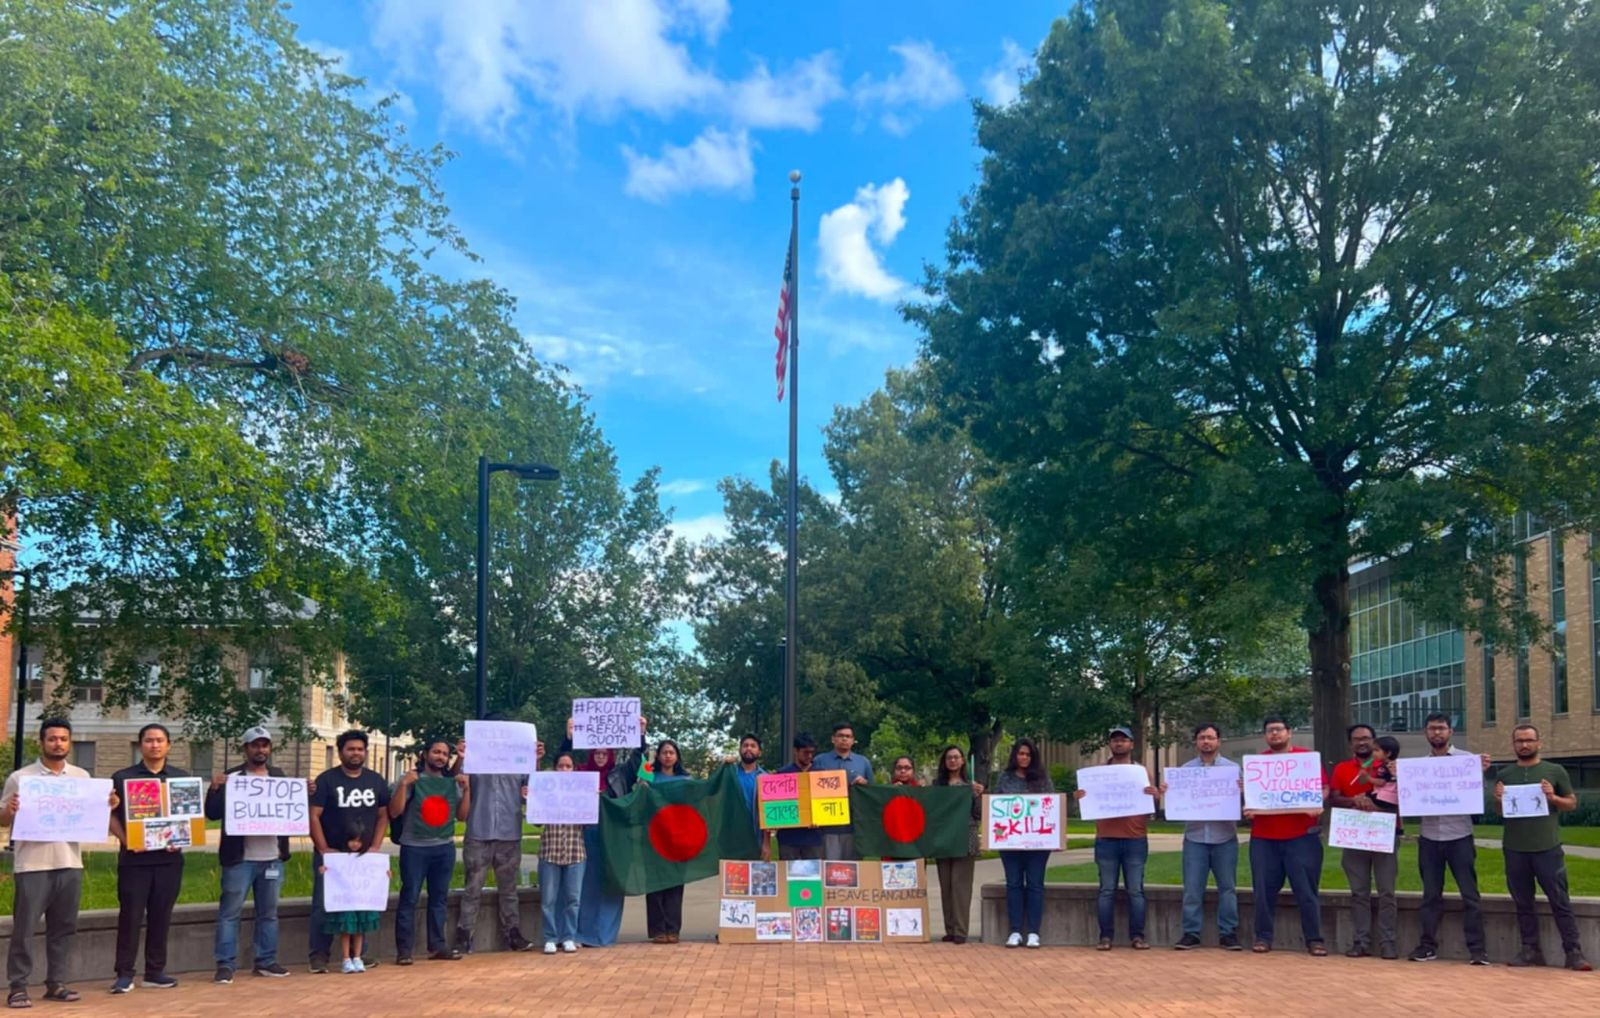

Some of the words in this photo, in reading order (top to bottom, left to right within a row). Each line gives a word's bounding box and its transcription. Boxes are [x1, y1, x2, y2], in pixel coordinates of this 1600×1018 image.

[574, 700, 640, 714] #PROTECT
[588, 714, 630, 725] MERIT
[573, 724, 637, 735] #REFORM
[587, 734, 628, 746] QUOTA
[1246, 759, 1298, 782] STOP
[234, 778, 303, 800] #STOP
[762, 775, 797, 794] দেশটা
[1260, 777, 1322, 791] VIOLENCE
[336, 786, 375, 807] Lee
[1280, 791, 1322, 803] CAMPUS
[233, 801, 306, 821] BULLETS
[991, 795, 1039, 819] STOP
[826, 889, 870, 902] #SAVE
